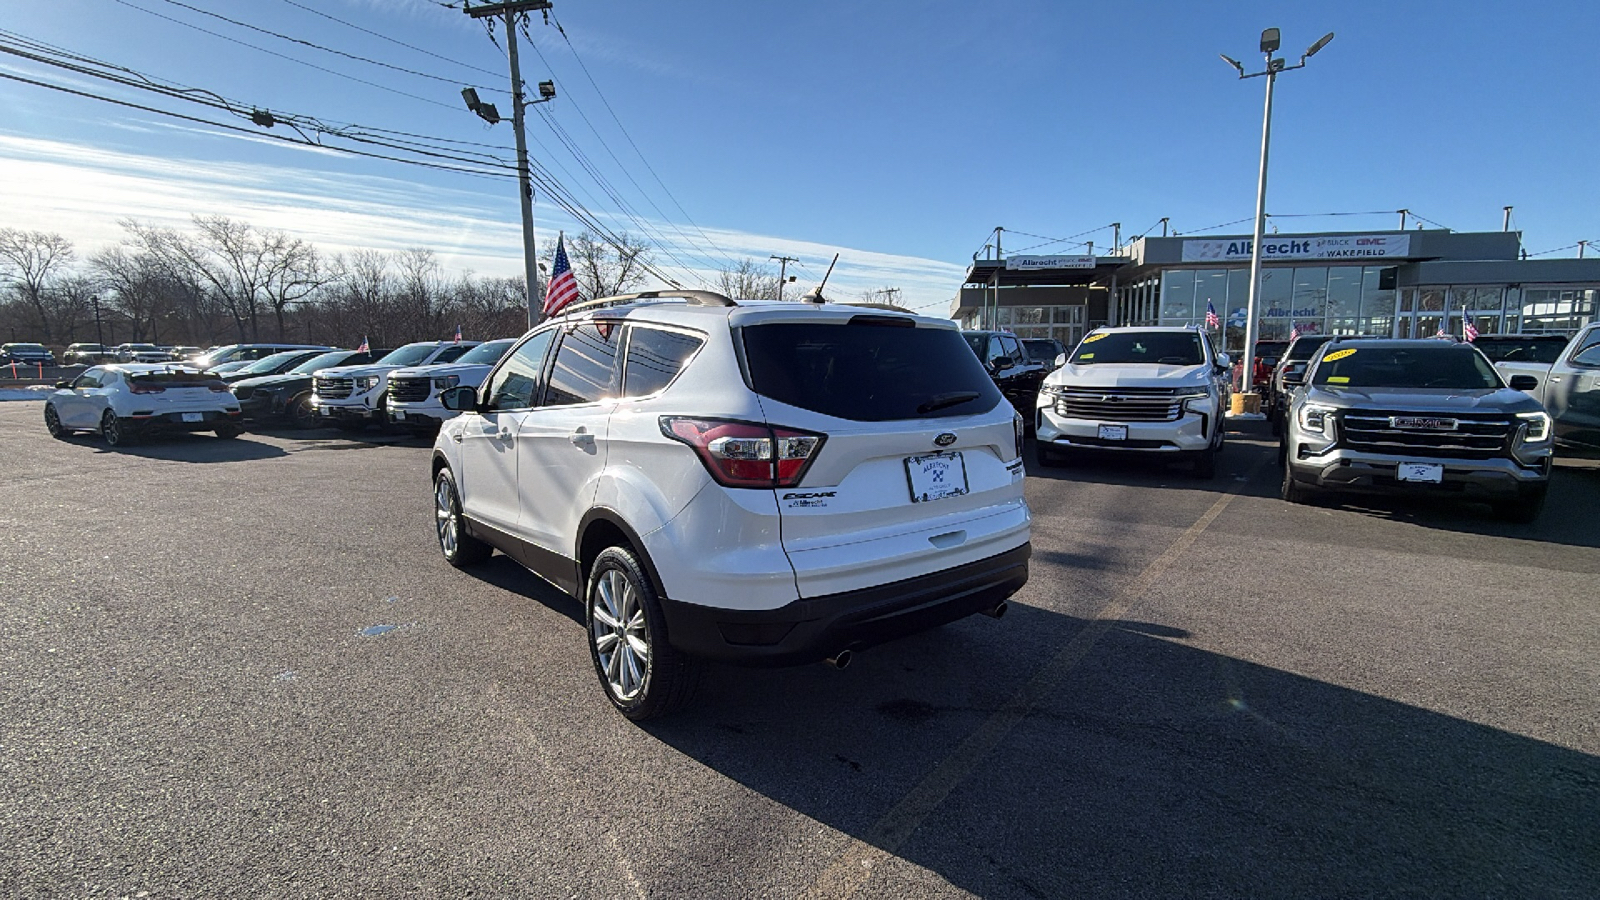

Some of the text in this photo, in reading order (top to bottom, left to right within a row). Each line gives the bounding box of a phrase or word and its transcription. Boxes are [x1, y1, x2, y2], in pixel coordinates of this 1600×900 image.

[1356, 238, 1386, 246] GMC
[1327, 249, 1386, 257] WAKEFIELD
[1267, 308, 1316, 317] Albrecht
[1395, 417, 1454, 428] GMC
[783, 491, 837, 500] ESCAPE
